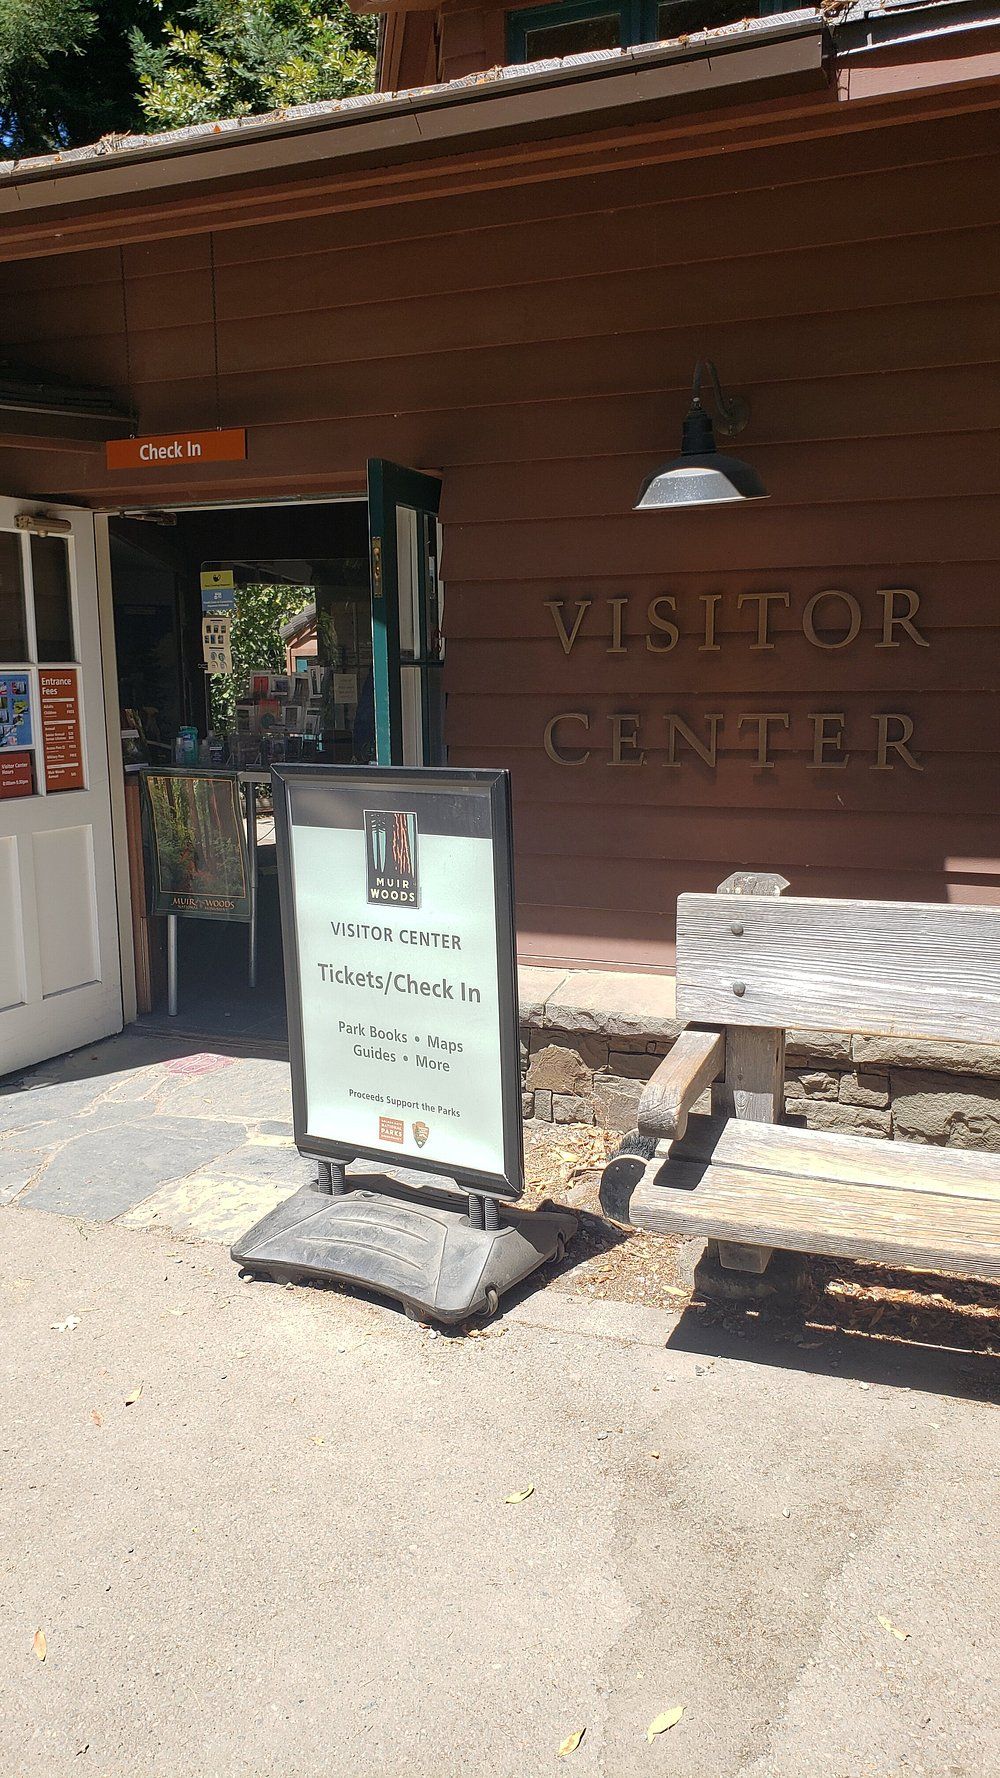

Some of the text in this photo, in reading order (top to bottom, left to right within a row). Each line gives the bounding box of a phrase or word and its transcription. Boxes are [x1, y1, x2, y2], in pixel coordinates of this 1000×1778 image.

[140, 441, 201, 460] Check In
[543, 588, 930, 655] VISITOR
[41, 677, 72, 686] Entrance
[42, 687, 59, 695] Fees
[543, 712, 924, 772] CENTER
[370, 888, 415, 902] WOODS
[376, 877, 409, 889] MUIR
[171, 897, 198, 906] MUIR
[204, 899, 235, 910] WOODS
[330, 921, 462, 951] VISITOR CENTER
[317, 962, 482, 1004] Tickets/Check In
[338, 1020, 464, 1054] Park Books Maps
[353, 1044, 451, 1073] Guides More
[348, 1088, 461, 1118] Proceeds Support the Parks
[381, 1128, 402, 1137] PARKS
